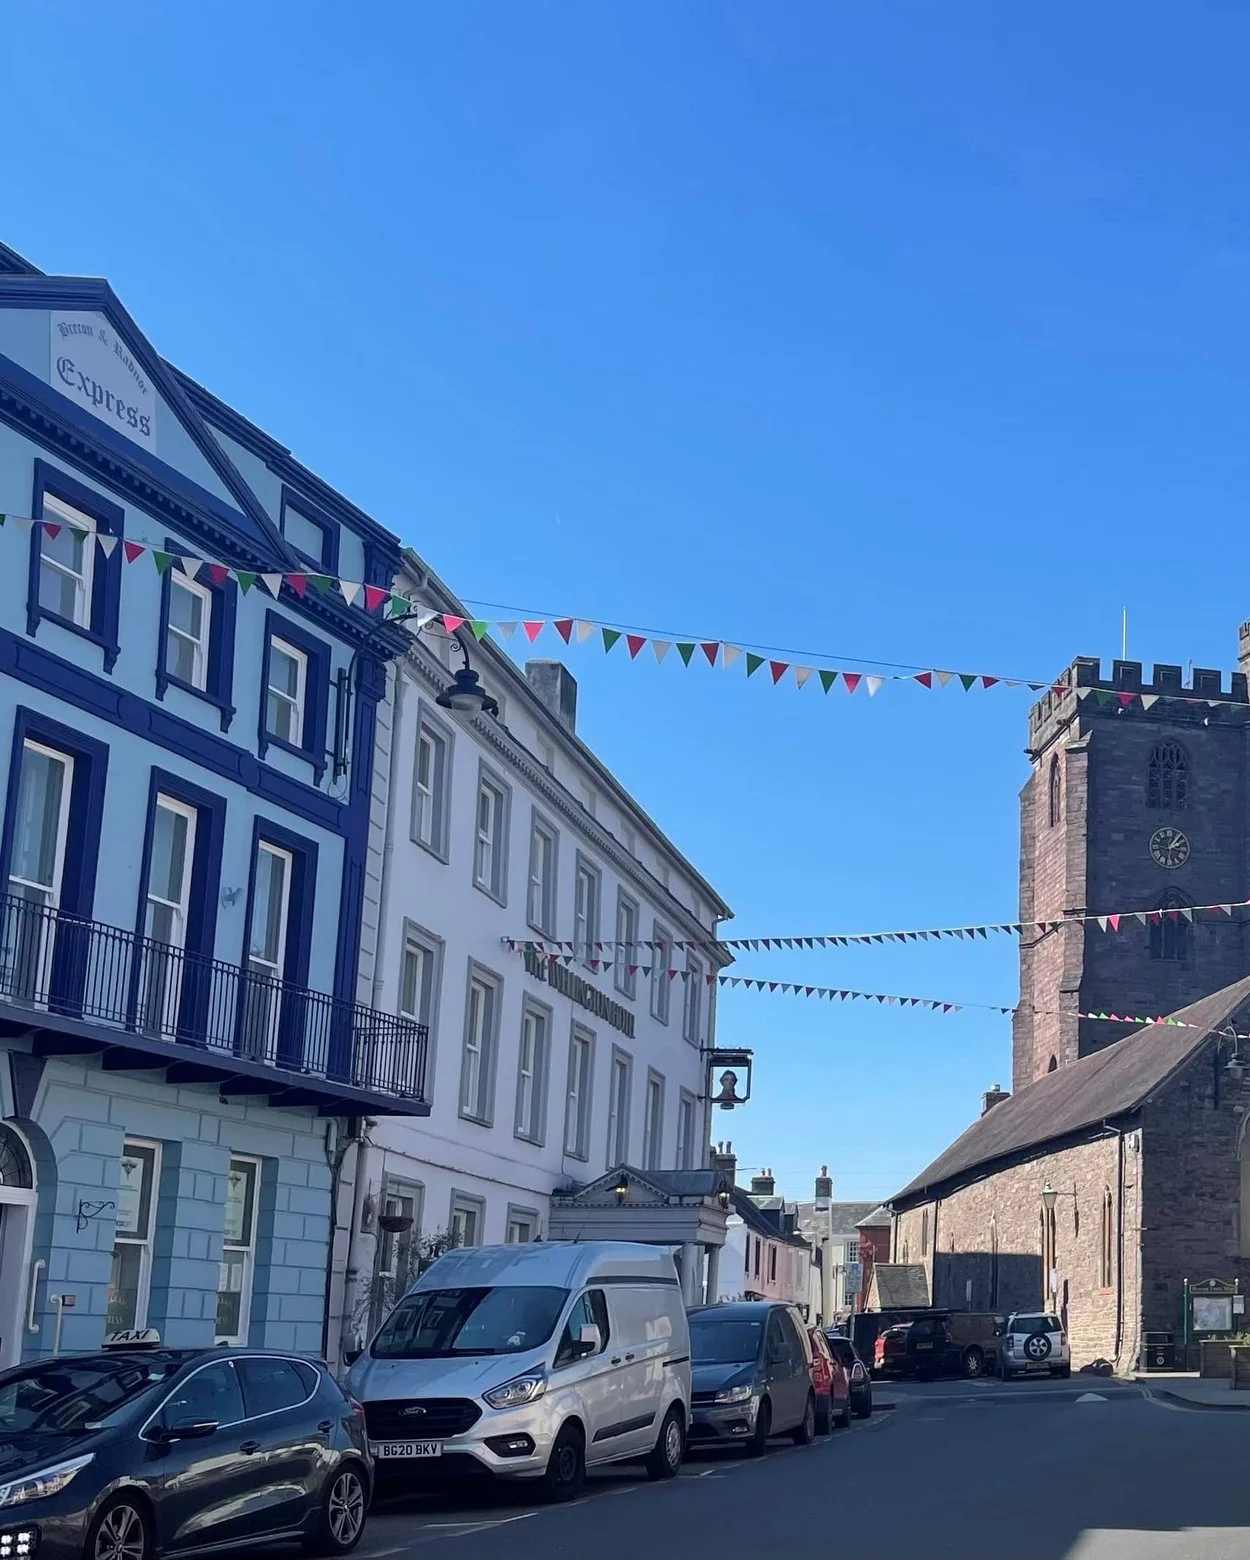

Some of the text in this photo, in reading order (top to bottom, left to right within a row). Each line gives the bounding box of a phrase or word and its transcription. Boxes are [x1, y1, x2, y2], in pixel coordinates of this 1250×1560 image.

[98, 329, 108, 346] &
[113, 342, 149, 395] Radnor
[56, 356, 151, 437] Express
[110, 1330, 150, 1342] TAXI
[383, 1443, 438, 1457] BG20 BKV
